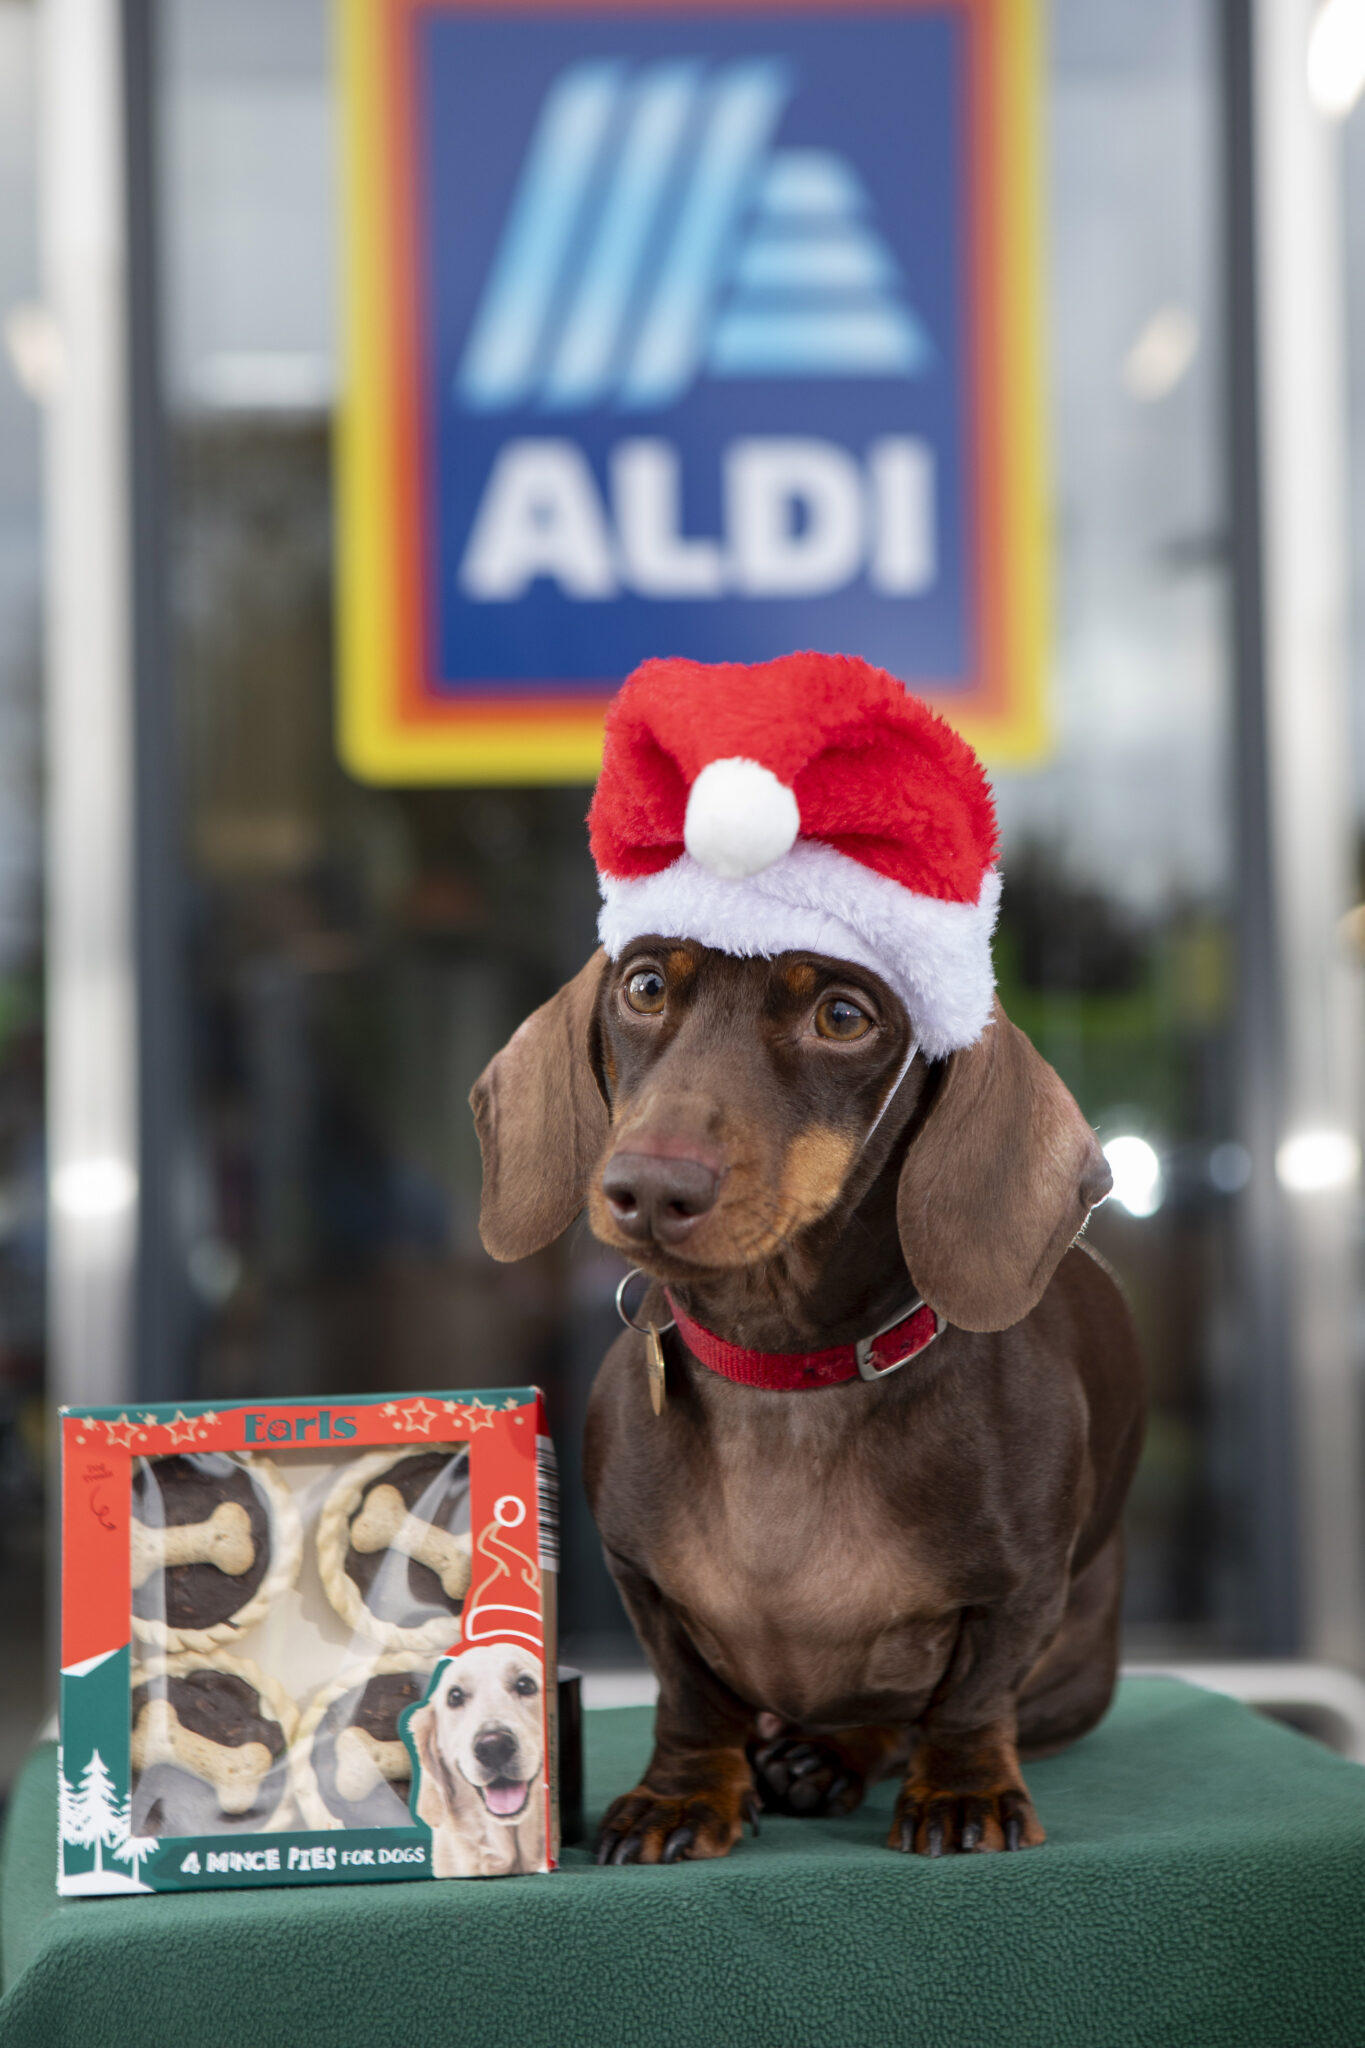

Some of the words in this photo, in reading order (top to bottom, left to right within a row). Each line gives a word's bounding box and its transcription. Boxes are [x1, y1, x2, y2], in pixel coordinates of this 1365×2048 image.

[460, 436, 937, 599] ALDI
[244, 1410, 358, 1443] Earls
[180, 1851, 201, 1874] 4
[206, 1847, 281, 1873] MINCE
[287, 1846, 337, 1871] PIES
[341, 1848, 376, 1866] FOR
[378, 1847, 426, 1865] DOGS
